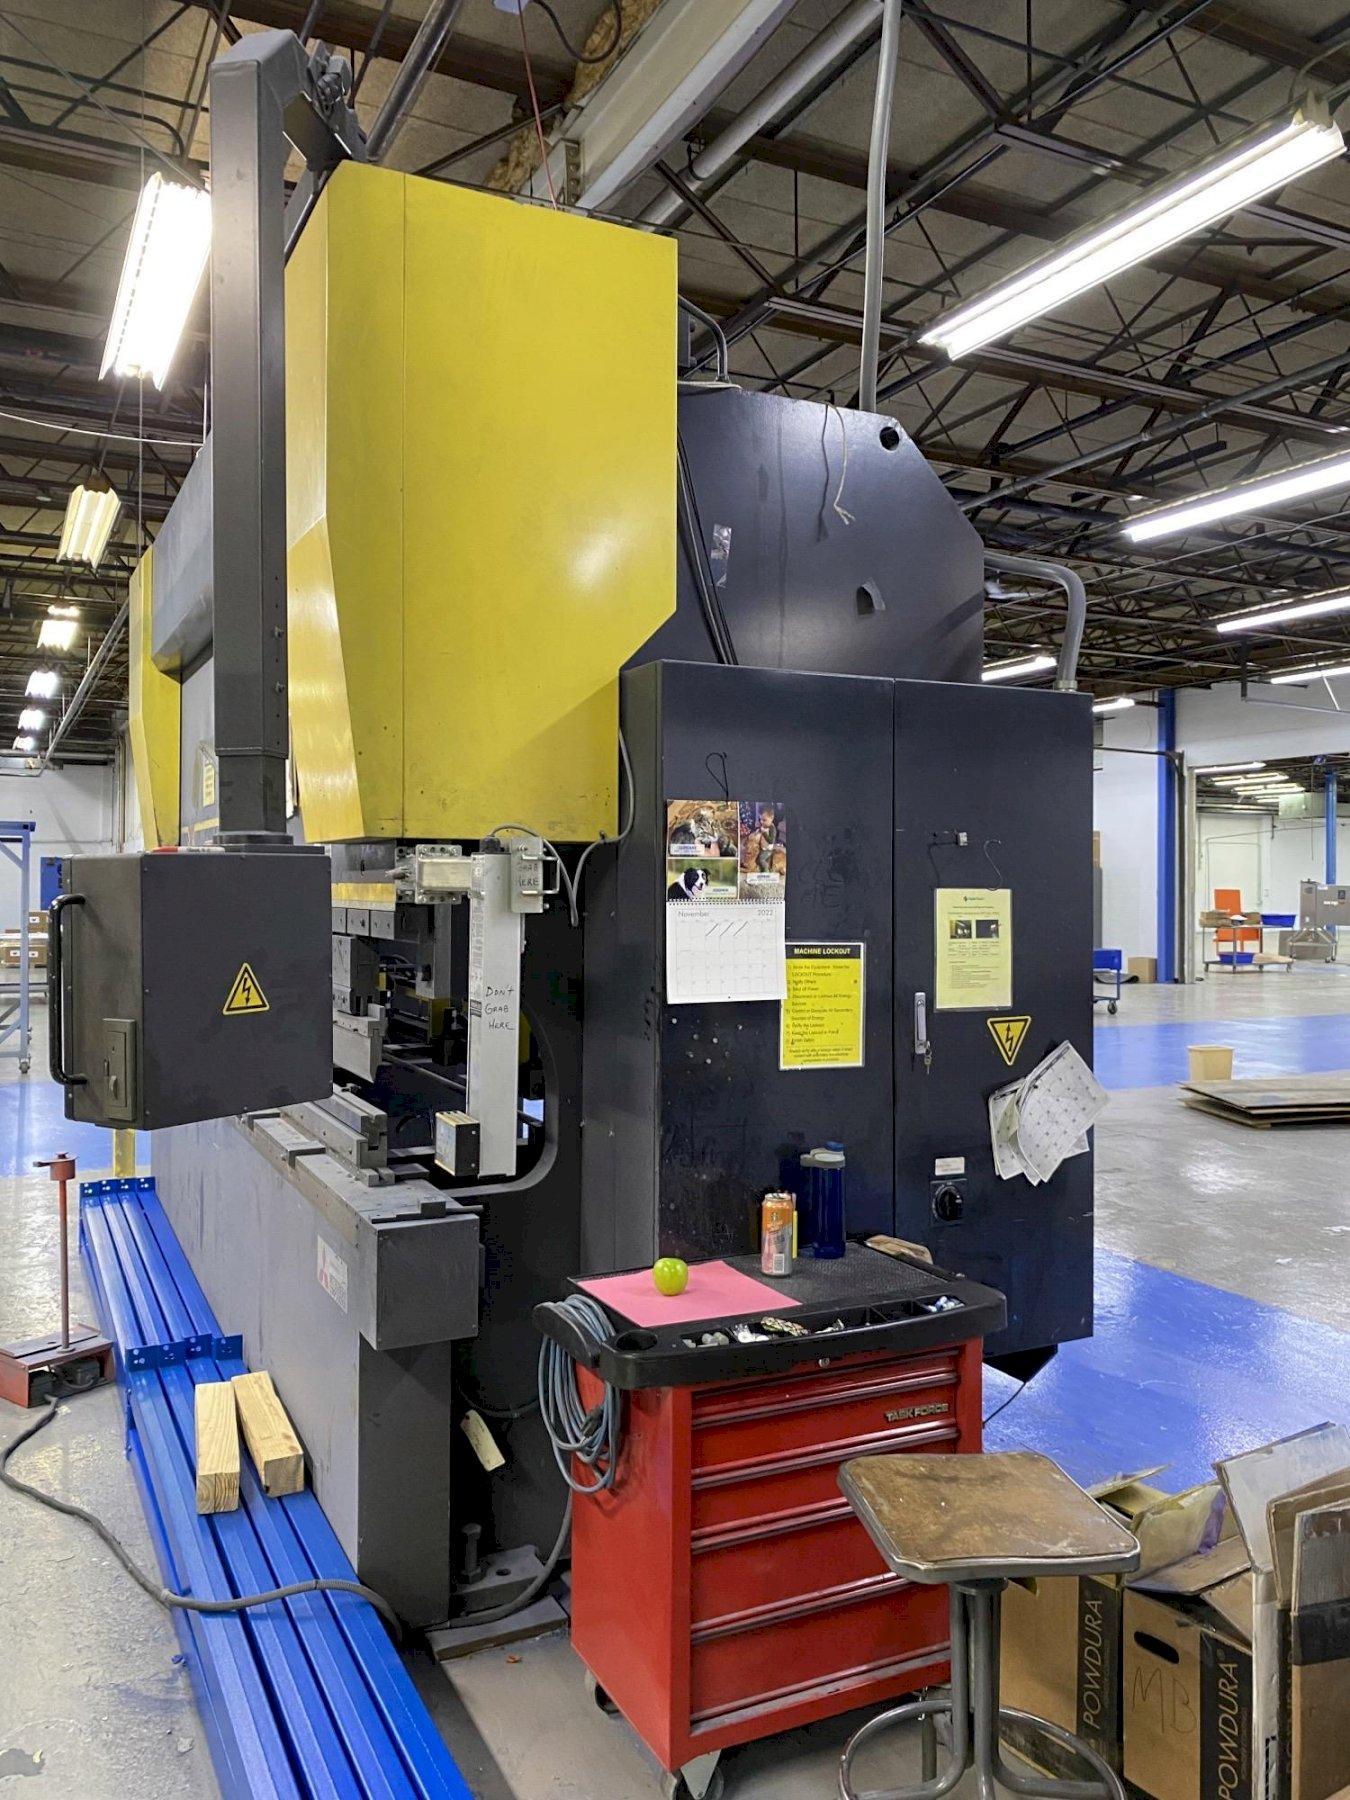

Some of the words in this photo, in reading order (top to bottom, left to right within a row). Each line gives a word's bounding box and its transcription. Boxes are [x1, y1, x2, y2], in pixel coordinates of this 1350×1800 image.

[794, 947, 821, 955] MACHINE
[822, 947, 851, 955] LOCKOUT
[886, 1408, 914, 1422] TASK
[914, 1402, 949, 1417] FORCE
[1083, 1600, 1103, 1729] POWDURA
[1218, 1662, 1239, 1800] POWDURA
